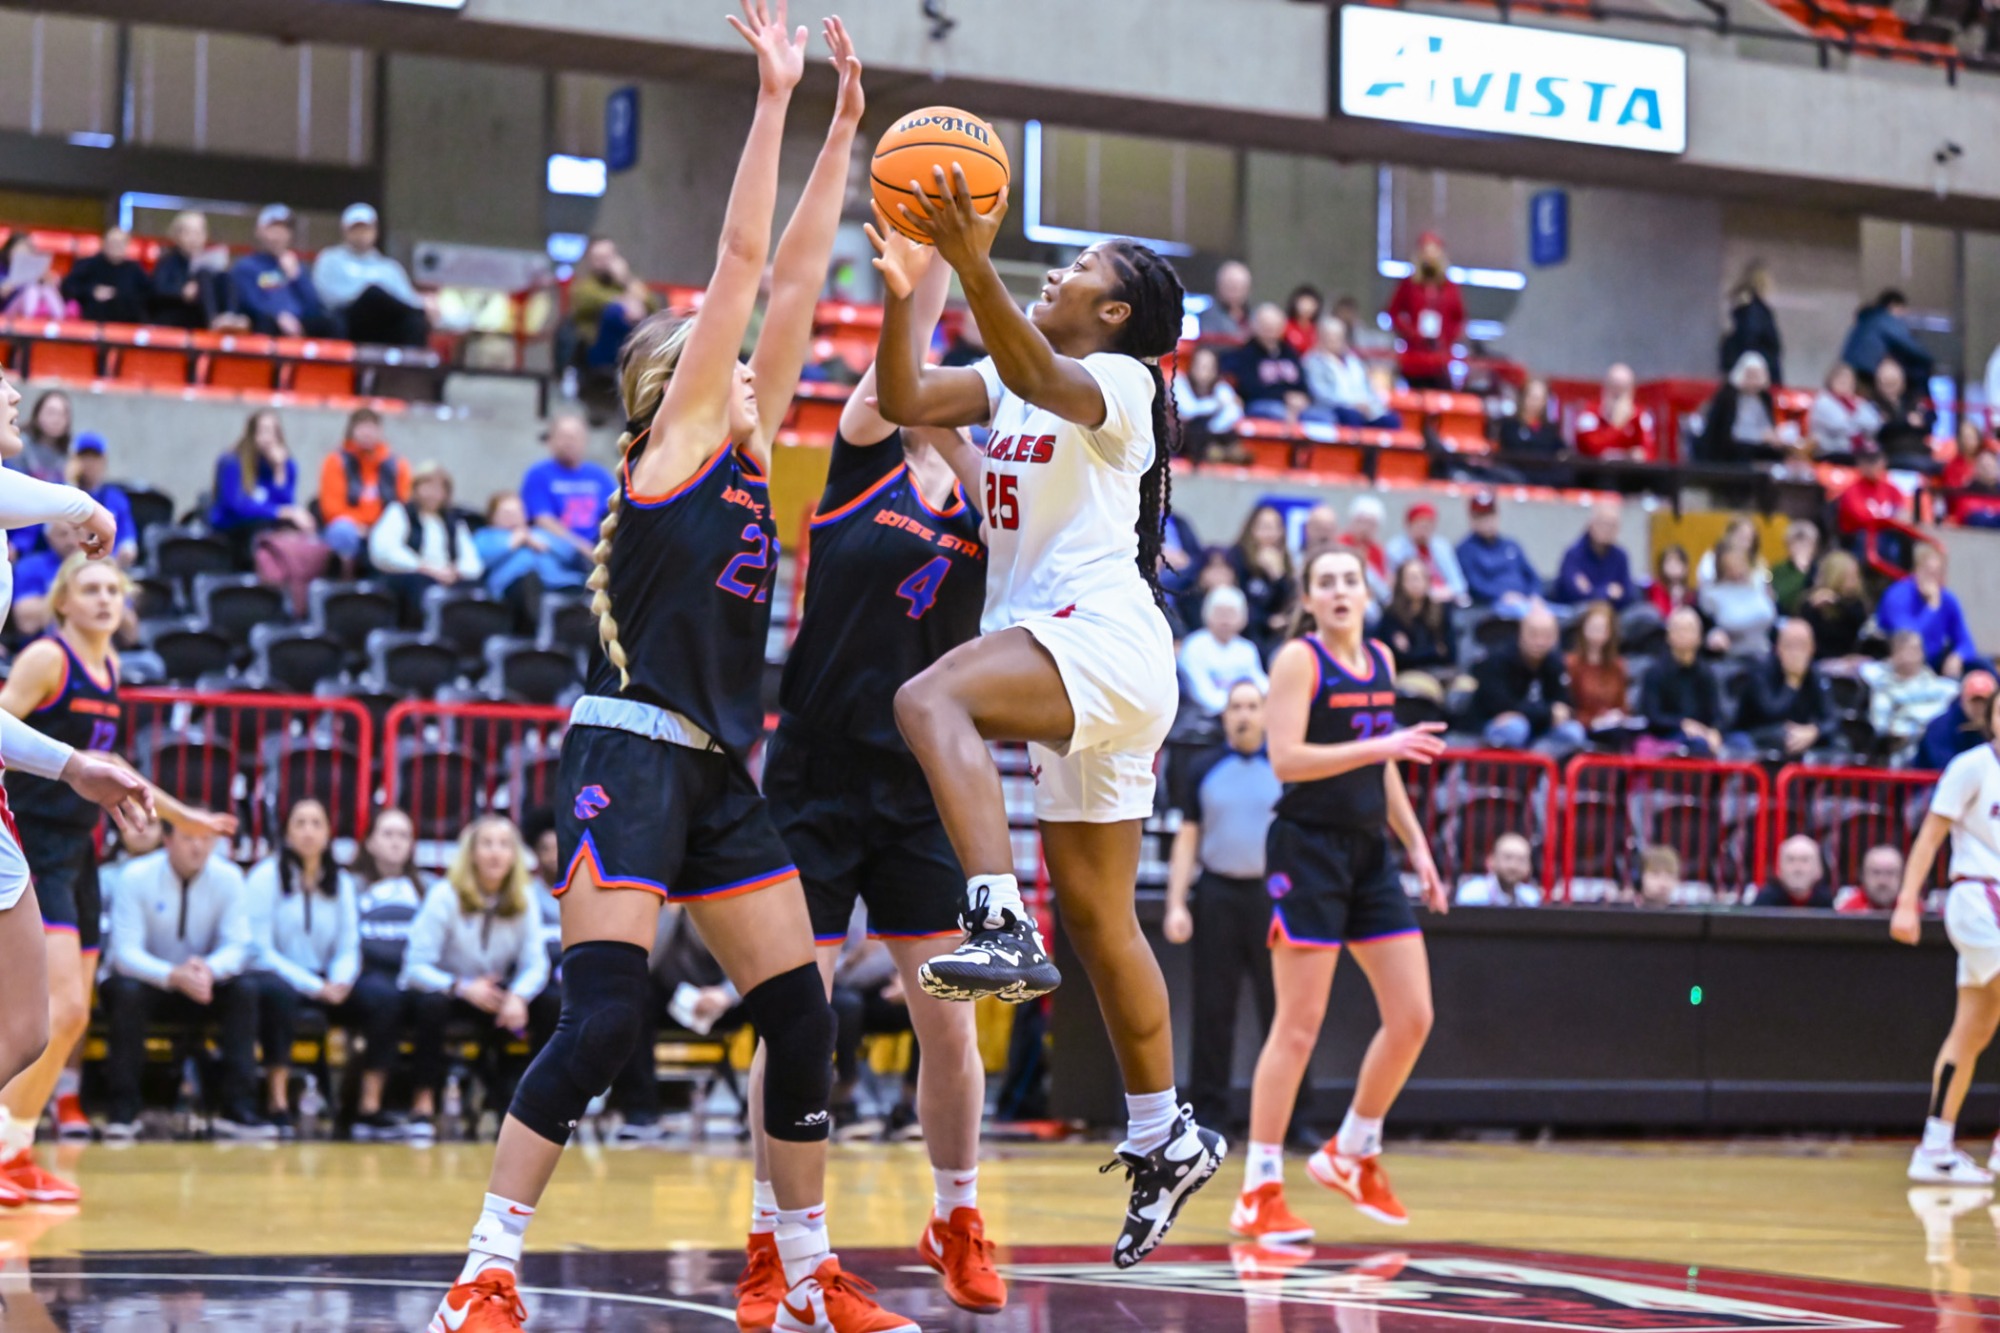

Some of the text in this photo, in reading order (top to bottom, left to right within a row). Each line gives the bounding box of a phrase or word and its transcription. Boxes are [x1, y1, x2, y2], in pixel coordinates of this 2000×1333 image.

[1364, 36, 1662, 130] AVISTA
[900, 115, 989, 146] Wilson
[986, 471, 1020, 530] 25
[874, 509, 985, 559] BOISE STA
[896, 555, 953, 619] 4
